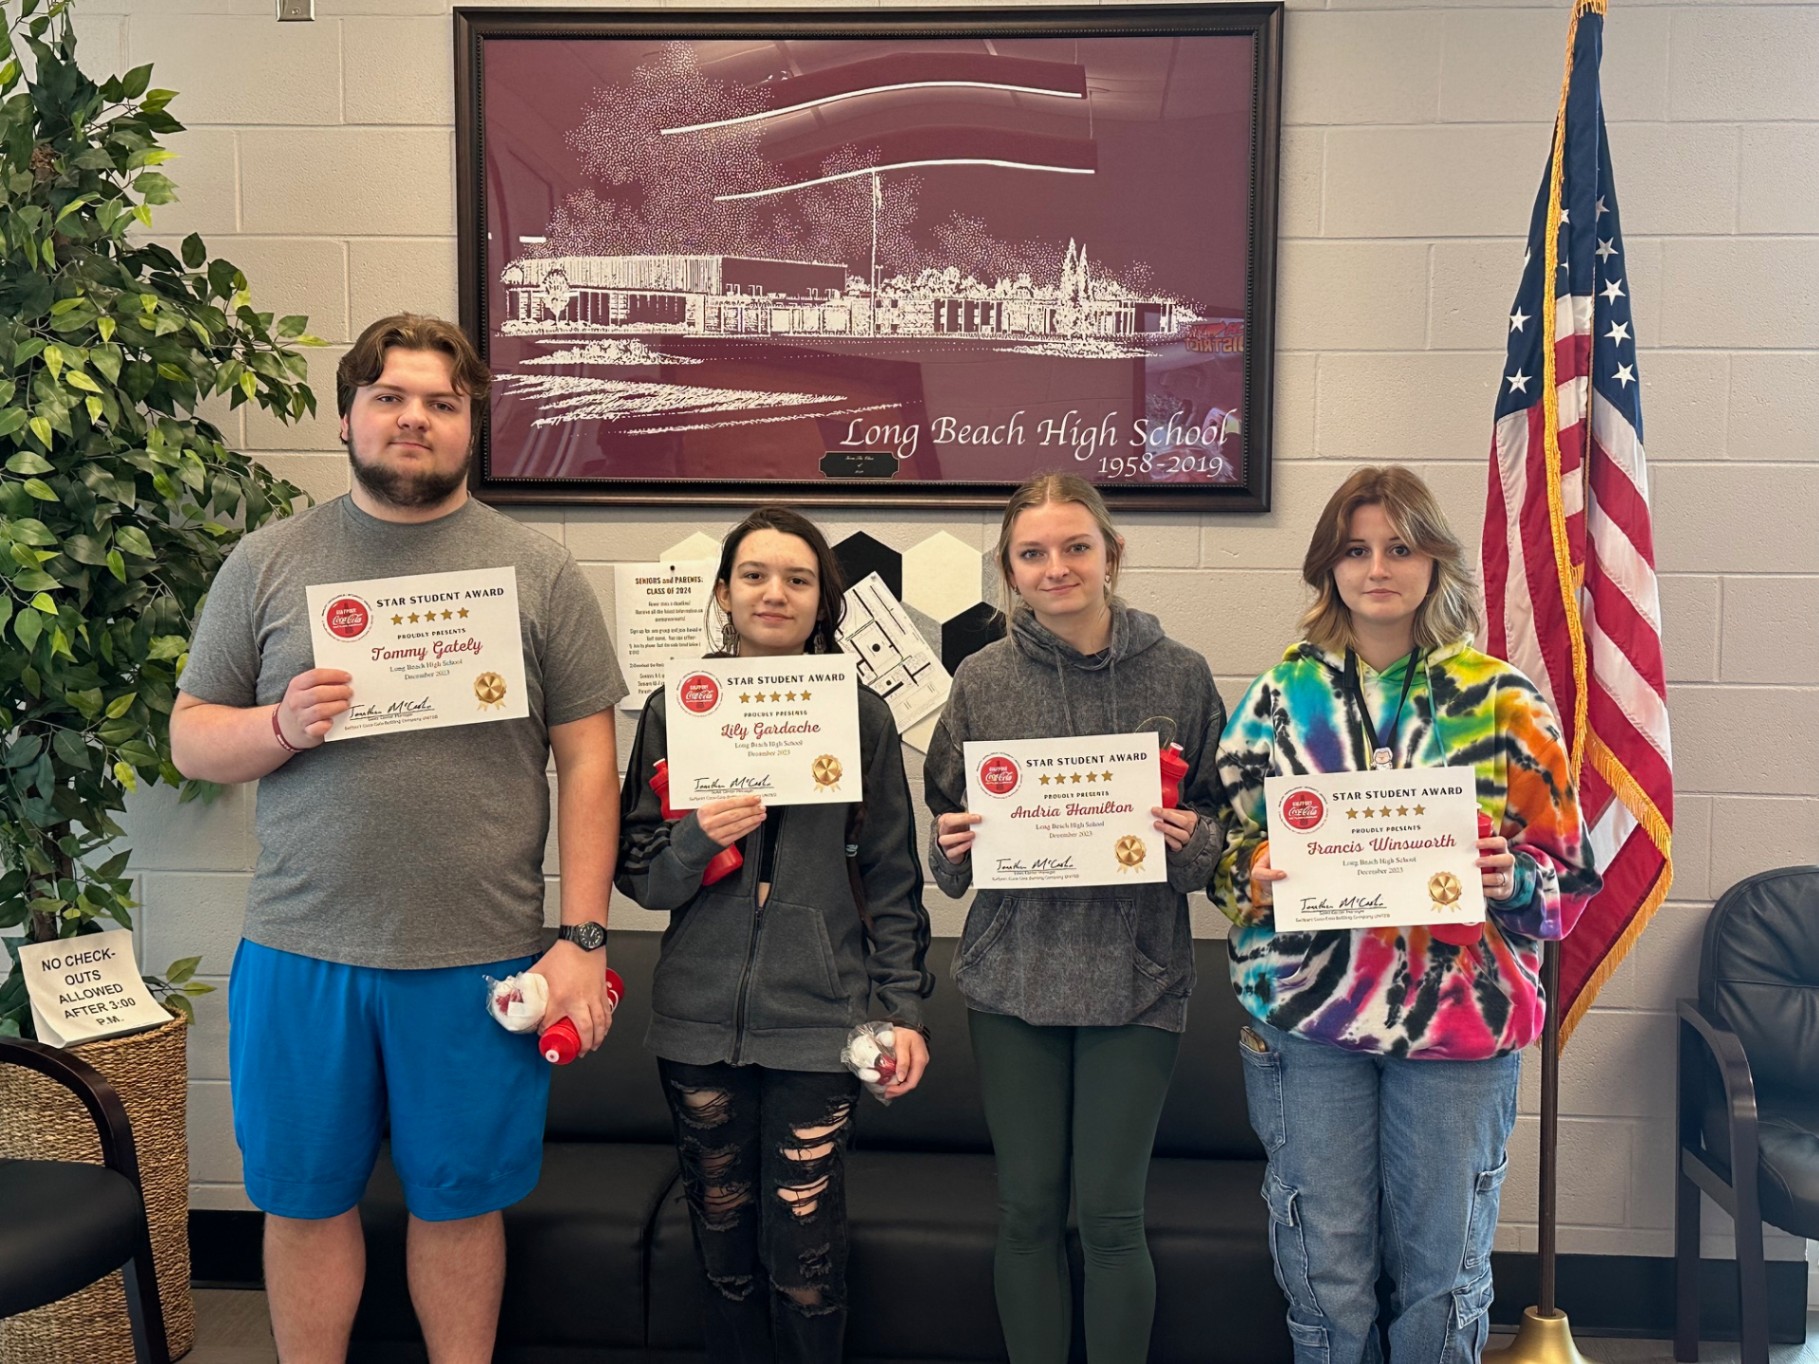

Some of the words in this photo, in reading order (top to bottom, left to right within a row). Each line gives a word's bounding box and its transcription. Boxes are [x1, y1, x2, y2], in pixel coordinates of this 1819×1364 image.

[839, 418, 920, 459] Long
[931, 410, 1026, 445] Beach
[1037, 410, 1118, 461] High
[1129, 408, 1237, 447] School
[1098, 453, 1223, 478] 1958-2019
[635, 577, 661, 585] SENIORS
[376, 597, 406, 608] STAR
[409, 591, 461, 605] STUDENT
[464, 587, 504, 599] AWARD
[646, 587, 666, 595] CLASS
[397, 632, 429, 640] PROUDLY
[432, 628, 466, 636] PRESENTS
[371, 646, 428, 662] Tommy
[432, 637, 483, 659] Gately
[407, 663, 425, 671] Beach
[426, 661, 441, 669] High
[404, 672, 434, 680] December
[727, 677, 754, 686] STAR
[757, 675, 804, 684] STUDENT
[808, 673, 845, 682] AWARD
[721, 723, 749, 741] Lily
[753, 720, 821, 740] Gardache
[1026, 759, 1053, 767] STAR
[1057, 755, 1105, 766] STUDENT
[1109, 752, 1147, 762] AWARD
[1332, 791, 1361, 801] STAR
[1365, 788, 1417, 800] STUDENT
[1421, 786, 1463, 796] AWARD
[1010, 805, 1060, 819] Andria
[1065, 801, 1134, 816] Hamilton
[1386, 825, 1421, 833] PRESENTS
[1307, 841, 1364, 856] Francis
[1369, 834, 1457, 851] Winsworth
[1342, 859, 1359, 867] Long
[1359, 858, 1378, 866] Beach
[1379, 858, 1394, 866] High
[1395, 856, 1417, 864] School
[1357, 868, 1387, 876] December
[41, 957, 62, 971] NO
[64, 948, 116, 967] CHECK-
[64, 969, 101, 986] OUTS
[59, 983, 123, 1005] ALLOWED
[64, 1002, 109, 1019] AFTER
[109, 997, 136, 1010] 3:00
[96, 1015, 124, 1026] P.M.
